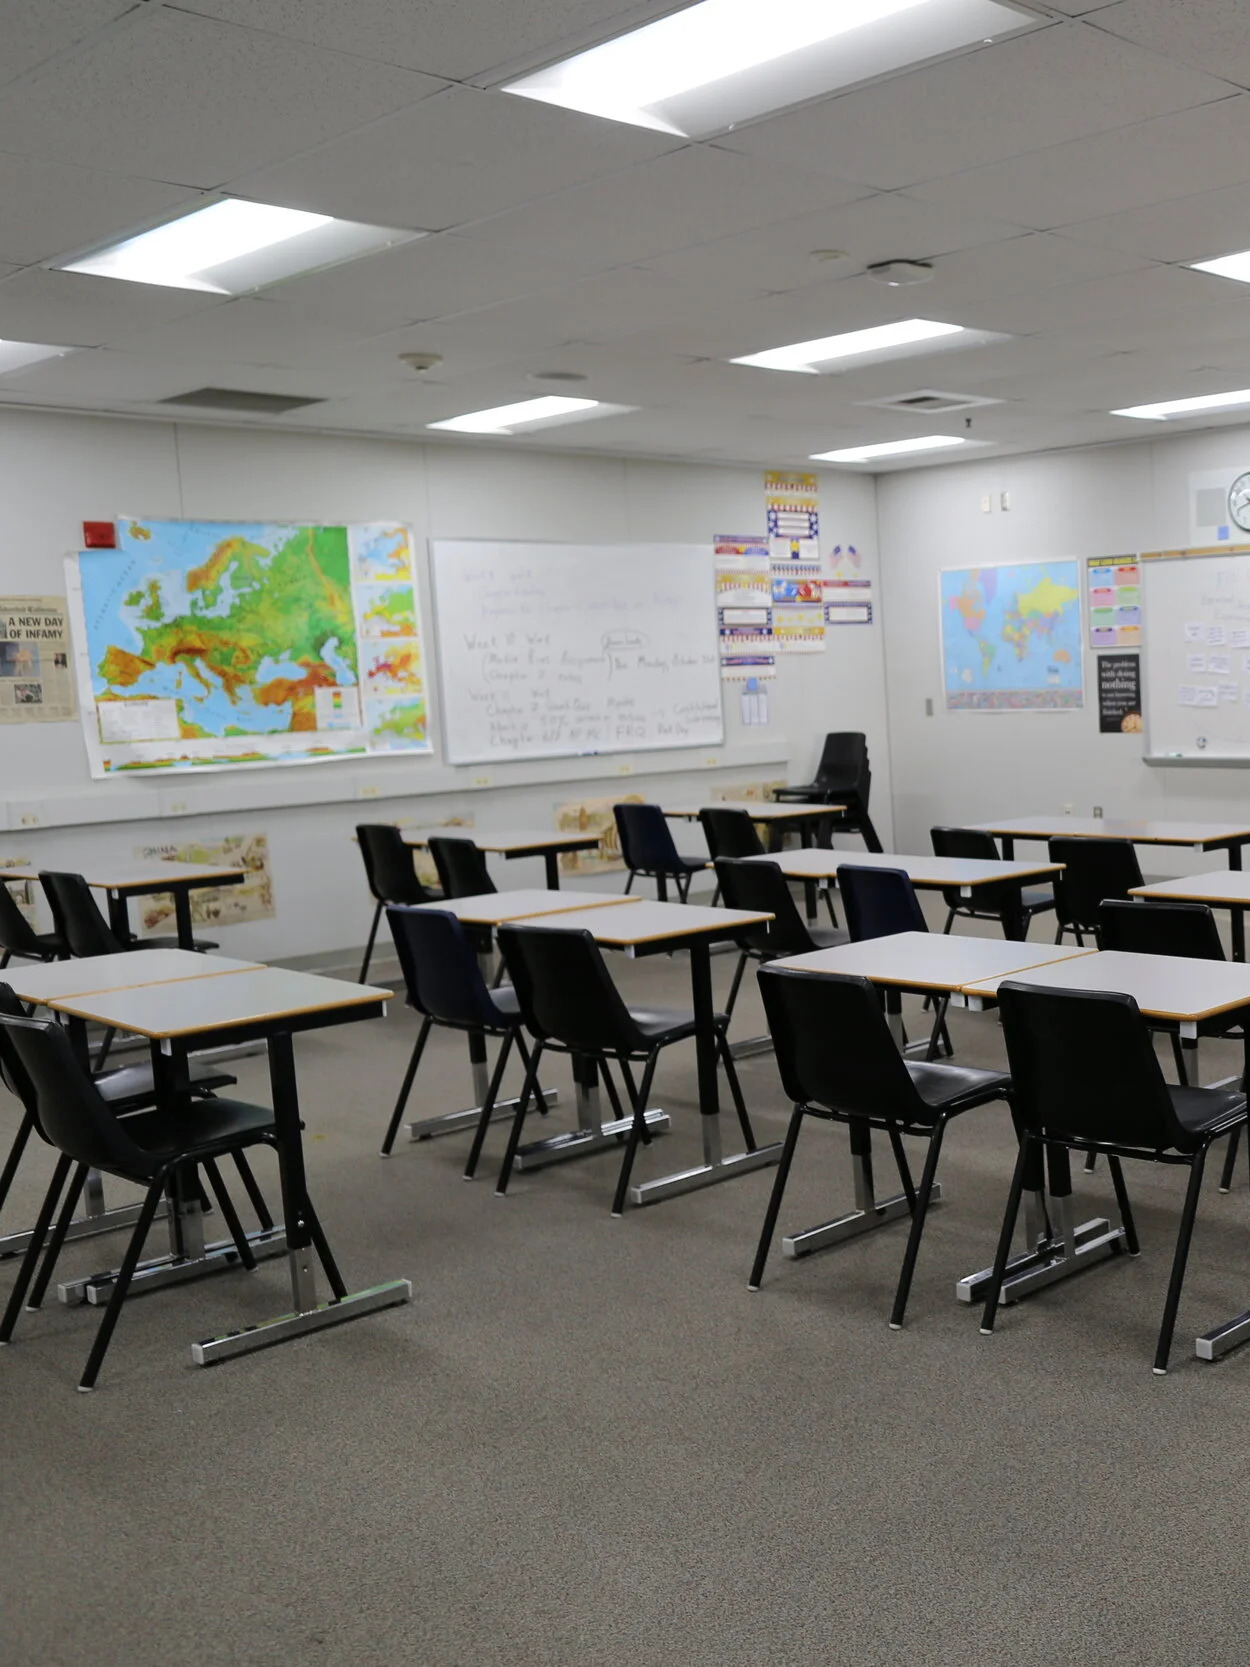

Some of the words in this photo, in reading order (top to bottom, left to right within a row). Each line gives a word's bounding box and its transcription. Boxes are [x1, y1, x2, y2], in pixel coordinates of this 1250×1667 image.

[8, 617, 15, 626] A
[18, 617, 41, 626] NEW
[44, 617, 64, 626] DAY
[9, 629, 22, 639] OF
[25, 629, 63, 639] INFAMY
[1101, 678, 1137, 691] nothing
